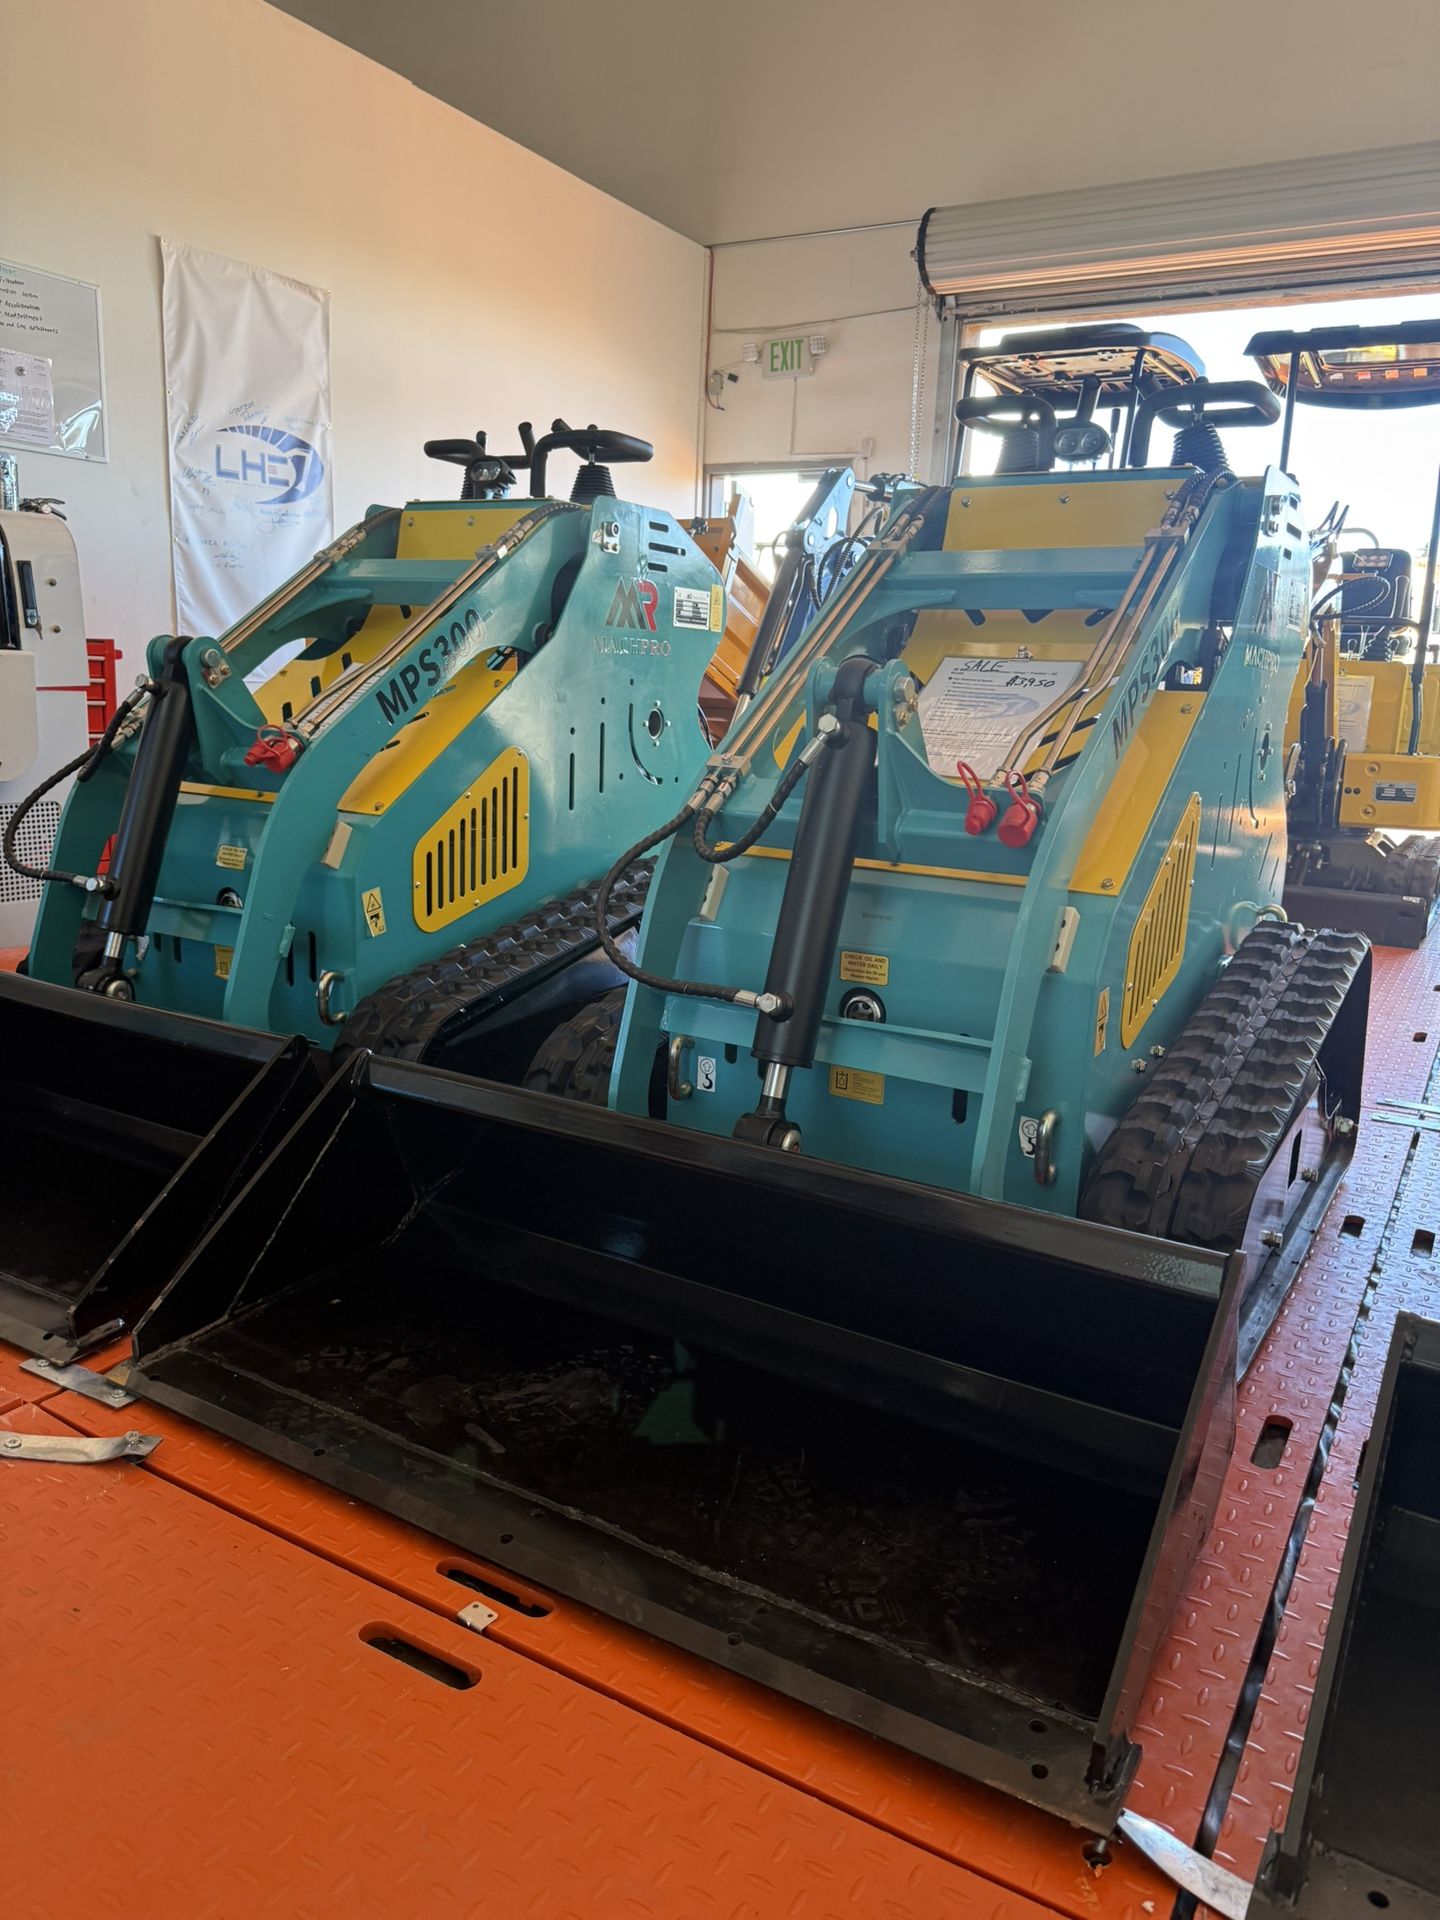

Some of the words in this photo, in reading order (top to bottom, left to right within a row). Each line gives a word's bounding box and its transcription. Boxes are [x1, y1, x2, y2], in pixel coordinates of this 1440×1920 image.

[770, 339, 804, 372] EXIT
[592, 634, 671, 657] MACHPRO
[375, 608, 485, 727] MPS300
[962, 659, 1009, 674] SALE
